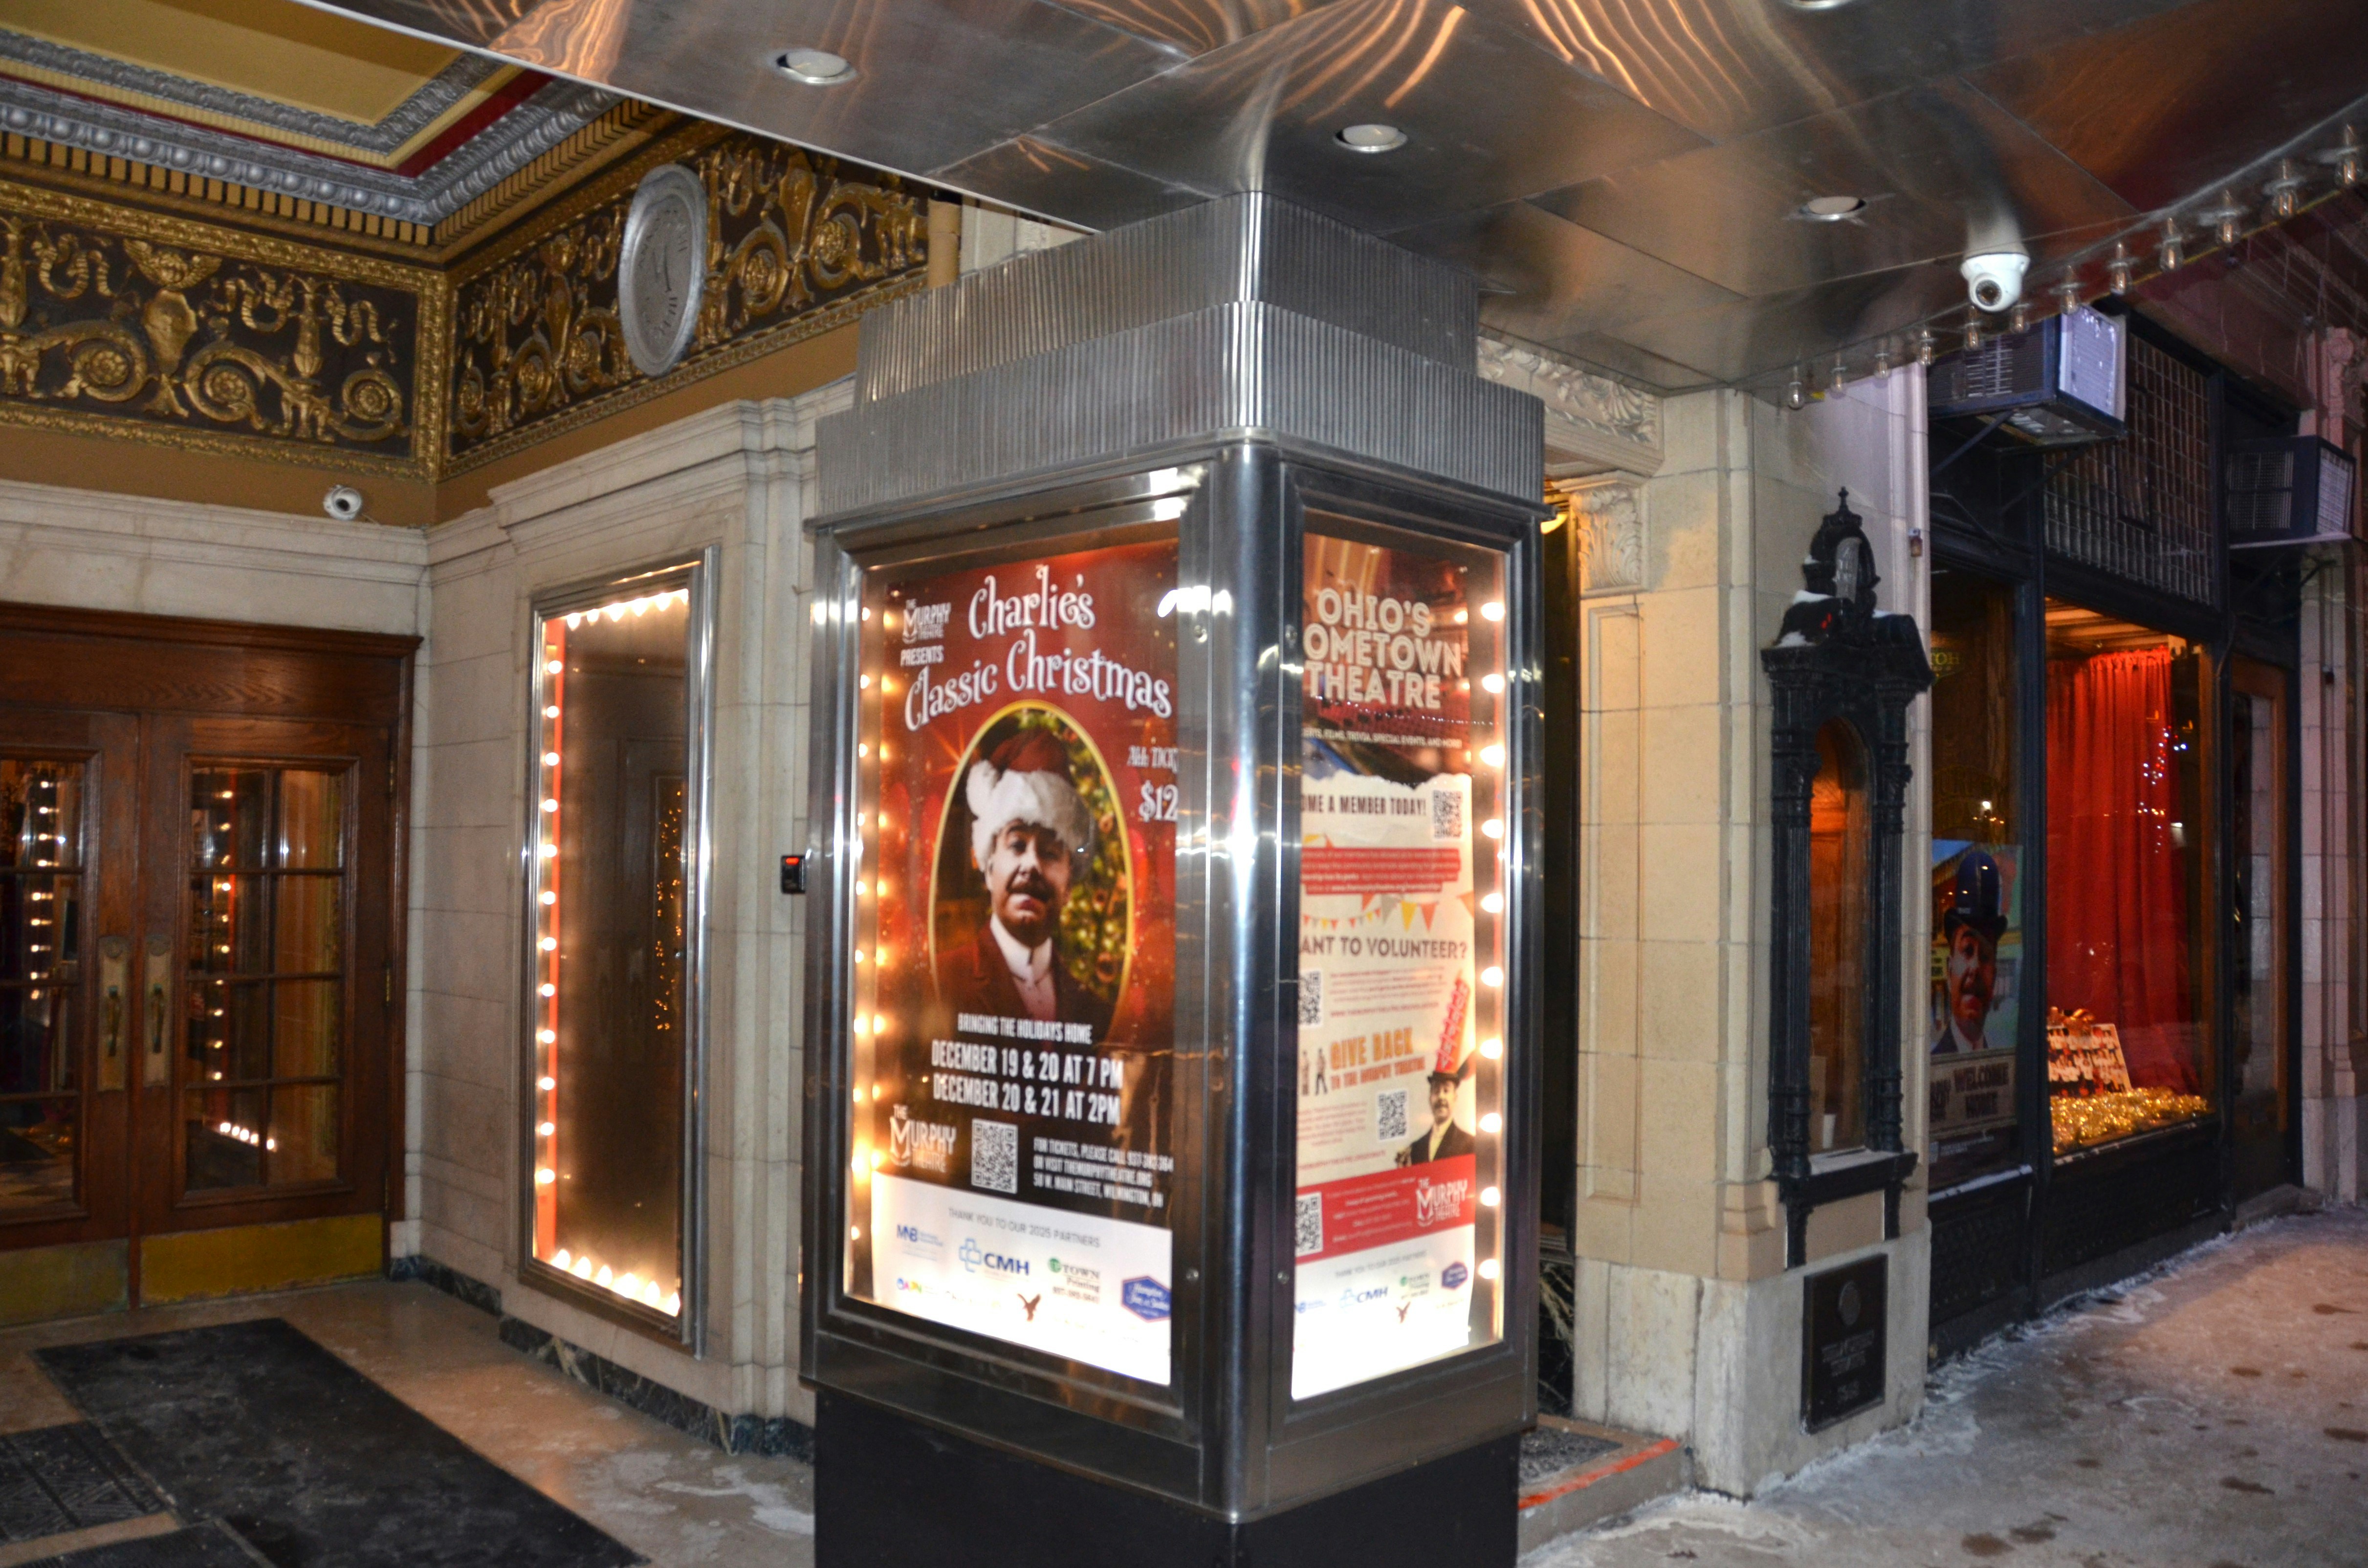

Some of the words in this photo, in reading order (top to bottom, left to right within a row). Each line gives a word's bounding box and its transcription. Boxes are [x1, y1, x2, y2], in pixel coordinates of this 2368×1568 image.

[968, 565, 1096, 639] Charlie's
[1317, 588, 1431, 637] OHIO'S
[903, 602, 951, 637] MURPHY
[900, 645, 944, 667] PRESENTS
[1303, 623, 1461, 677] OMETOWN
[905, 660, 998, 732] Classic
[1007, 629, 1172, 719] Christmas
[1304, 660, 1441, 709] THEATRE
[1324, 729, 1346, 741] FILMS,
[1346, 731, 1372, 743] TRIVIA,
[1373, 733, 1401, 745] SPECIAL
[1427, 737, 1441, 747] AND
[1150, 746, 1179, 774] TICK
[1329, 795, 1335, 812] A
[1340, 796, 1386, 815] MEMBER
[1390, 797, 1426, 816] TODAY!
[1301, 935, 1335, 956] ANT
[1340, 936, 1362, 958] TO
[1367, 937, 1468, 959] VOLUNTEER?
[957, 1012, 998, 1035] BRINGING
[999, 1016, 1015, 1037] THE
[1016, 1019, 1063, 1042] HOLIDAYS
[1064, 1023, 1093, 1045] HOME
[931, 1039, 997, 1074] DECEMBER
[1002, 1047, 1019, 1077] 19
[1022, 1050, 1035, 1079] &
[1039, 1051, 1060, 1082] 20
[1063, 1054, 1083, 1084] AT
[1086, 1056, 1096, 1086] 7
[1100, 1058, 1124, 1089] PM
[1330, 1035, 1367, 1071] GIVE
[1373, 1026, 1414, 1063] BACK
[1953, 1062, 2010, 1093] WELCOME
[893, 1104, 909, 1119] THE
[933, 1072, 999, 1109] DECEMBER
[1002, 1082, 1021, 1112] 20
[1025, 1086, 1037, 1114] &
[1041, 1086, 1059, 1117] 21
[1065, 1090, 1085, 1120] AT
[1088, 1092, 1120, 1126] 2PM
[890, 1116, 957, 1159] MURPHY
[1033, 1136, 1048, 1153] FOR
[1049, 1139, 1080, 1159] TICKETS,
[1081, 1143, 1107, 1162] PLEASE
[1108, 1148, 1126, 1165] CALL
[1033, 1154, 1044, 1170] OR
[1045, 1155, 1063, 1172] VISIT
[1064, 1158, 1153, 1188] THEMURPHYTHEATRE.ORG
[1418, 1176, 1430, 1189] THE
[1033, 1171, 1044, 1187] 50
[1054, 1175, 1074, 1192] MAIN
[1074, 1178, 1102, 1198] STREET,
[1103, 1183, 1151, 1207] WILMINGTON,
[1152, 1191, 1163, 1208] OH
[1416, 1178, 1468, 1221] MURPHY
[948, 1208, 973, 1221] THANK
[976, 1214, 993, 1226] YOU
[995, 1218, 1006, 1230] TO
[1008, 1220, 1026, 1233] OUR
[1029, 1224, 1051, 1239] 2025
[1053, 1229, 1100, 1248] PARTNERS
[984, 1252, 1030, 1276] CMH
[1061, 1264, 1099, 1279] TOWN
[1357, 1286, 1388, 1303] CMH
